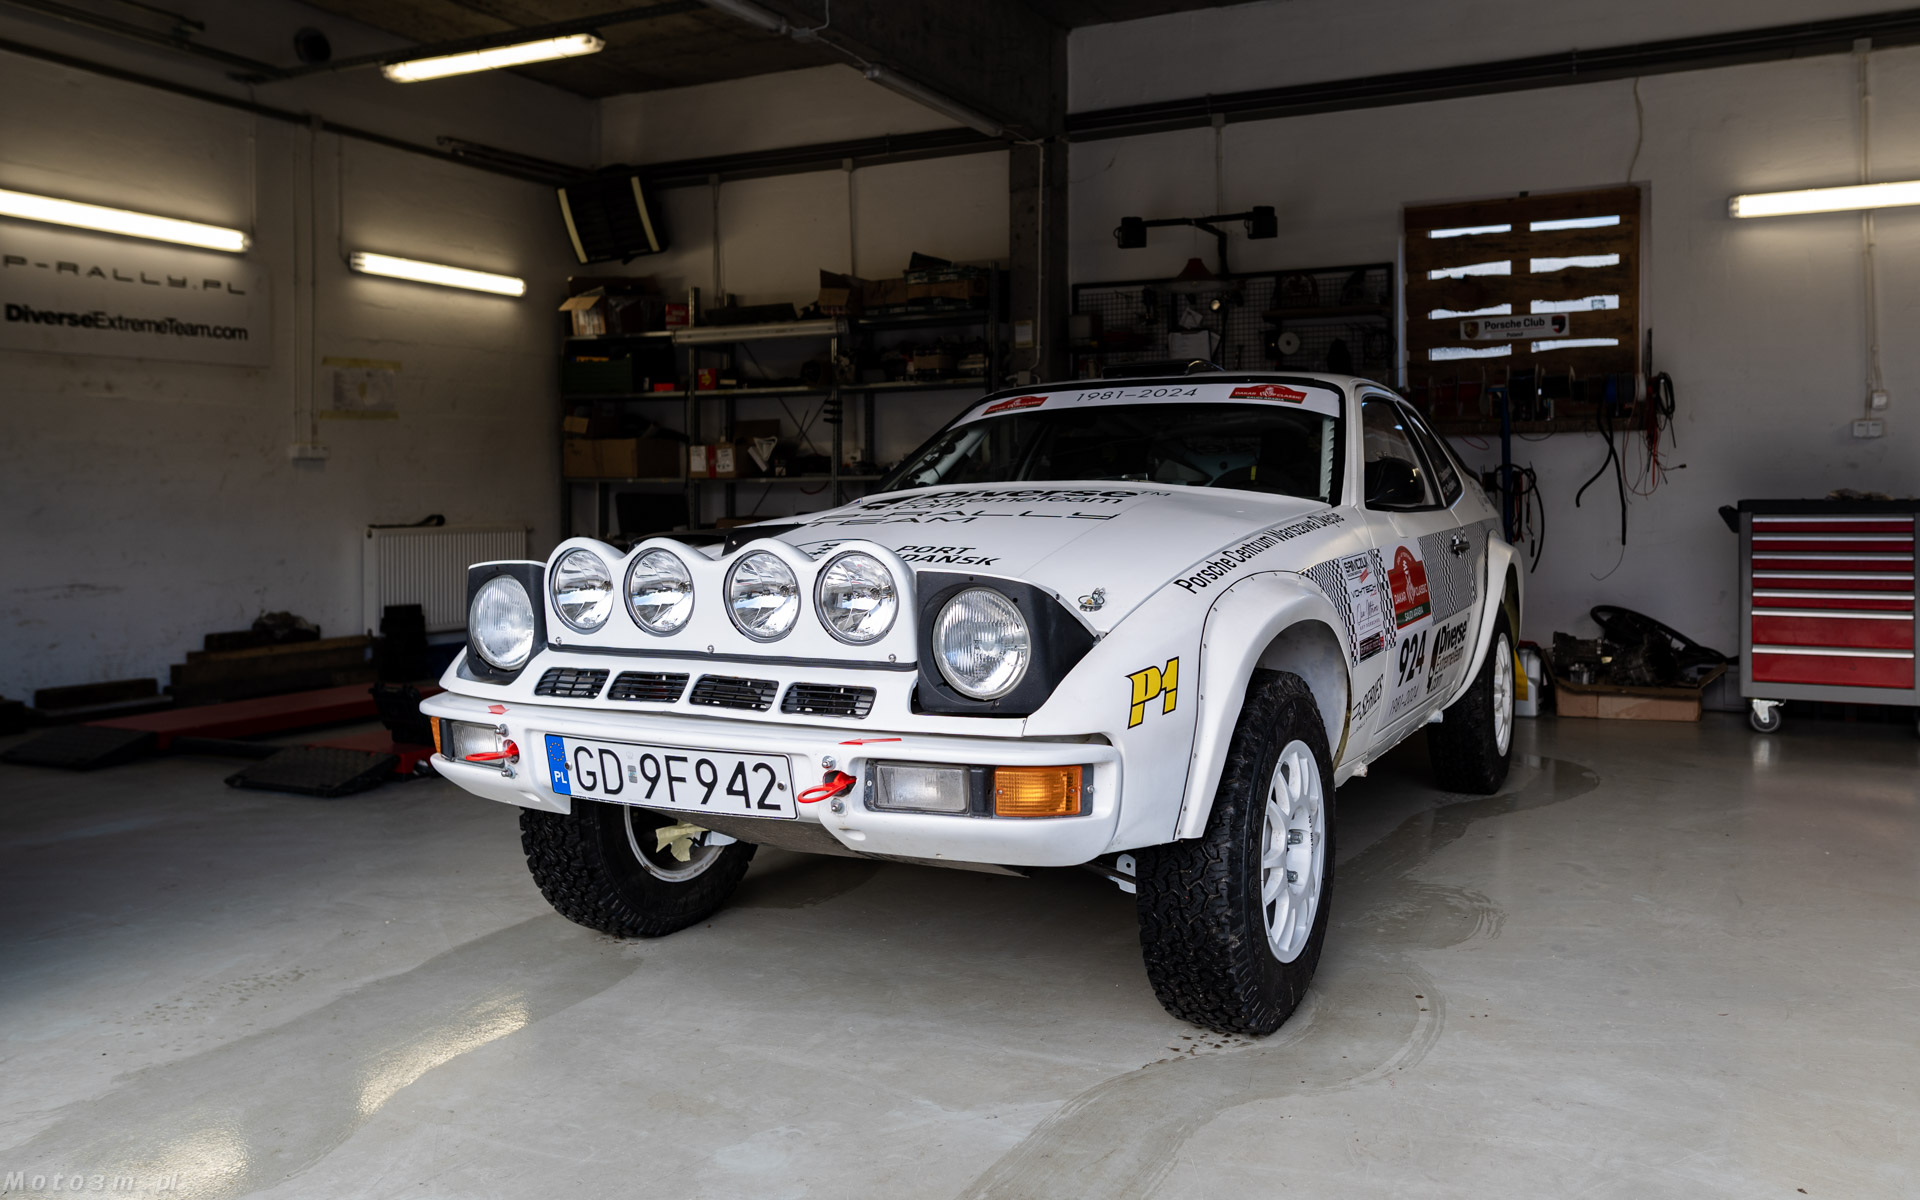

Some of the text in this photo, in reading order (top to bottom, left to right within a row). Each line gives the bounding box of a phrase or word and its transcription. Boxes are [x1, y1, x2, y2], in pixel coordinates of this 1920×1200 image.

[3, 254, 247, 296] P-RALLY.PL
[4, 303, 248, 341] DiverseExtremeTeam.com
[1484, 318, 1545, 330] Porsche Club
[806, 517, 978, 528] TEAM
[895, 545, 977, 555] PORT
[898, 553, 1001, 566] DAŃSK
[1173, 557, 1238, 595] Porsche
[1222, 535, 1279, 563] Centrum
[1263, 520, 1322, 542] Warszawa
[1440, 620, 1467, 655] Diverse
[1398, 630, 1427, 687] 924
[554, 770, 568, 785] PL
[573, 746, 782, 811] GD 9F942
